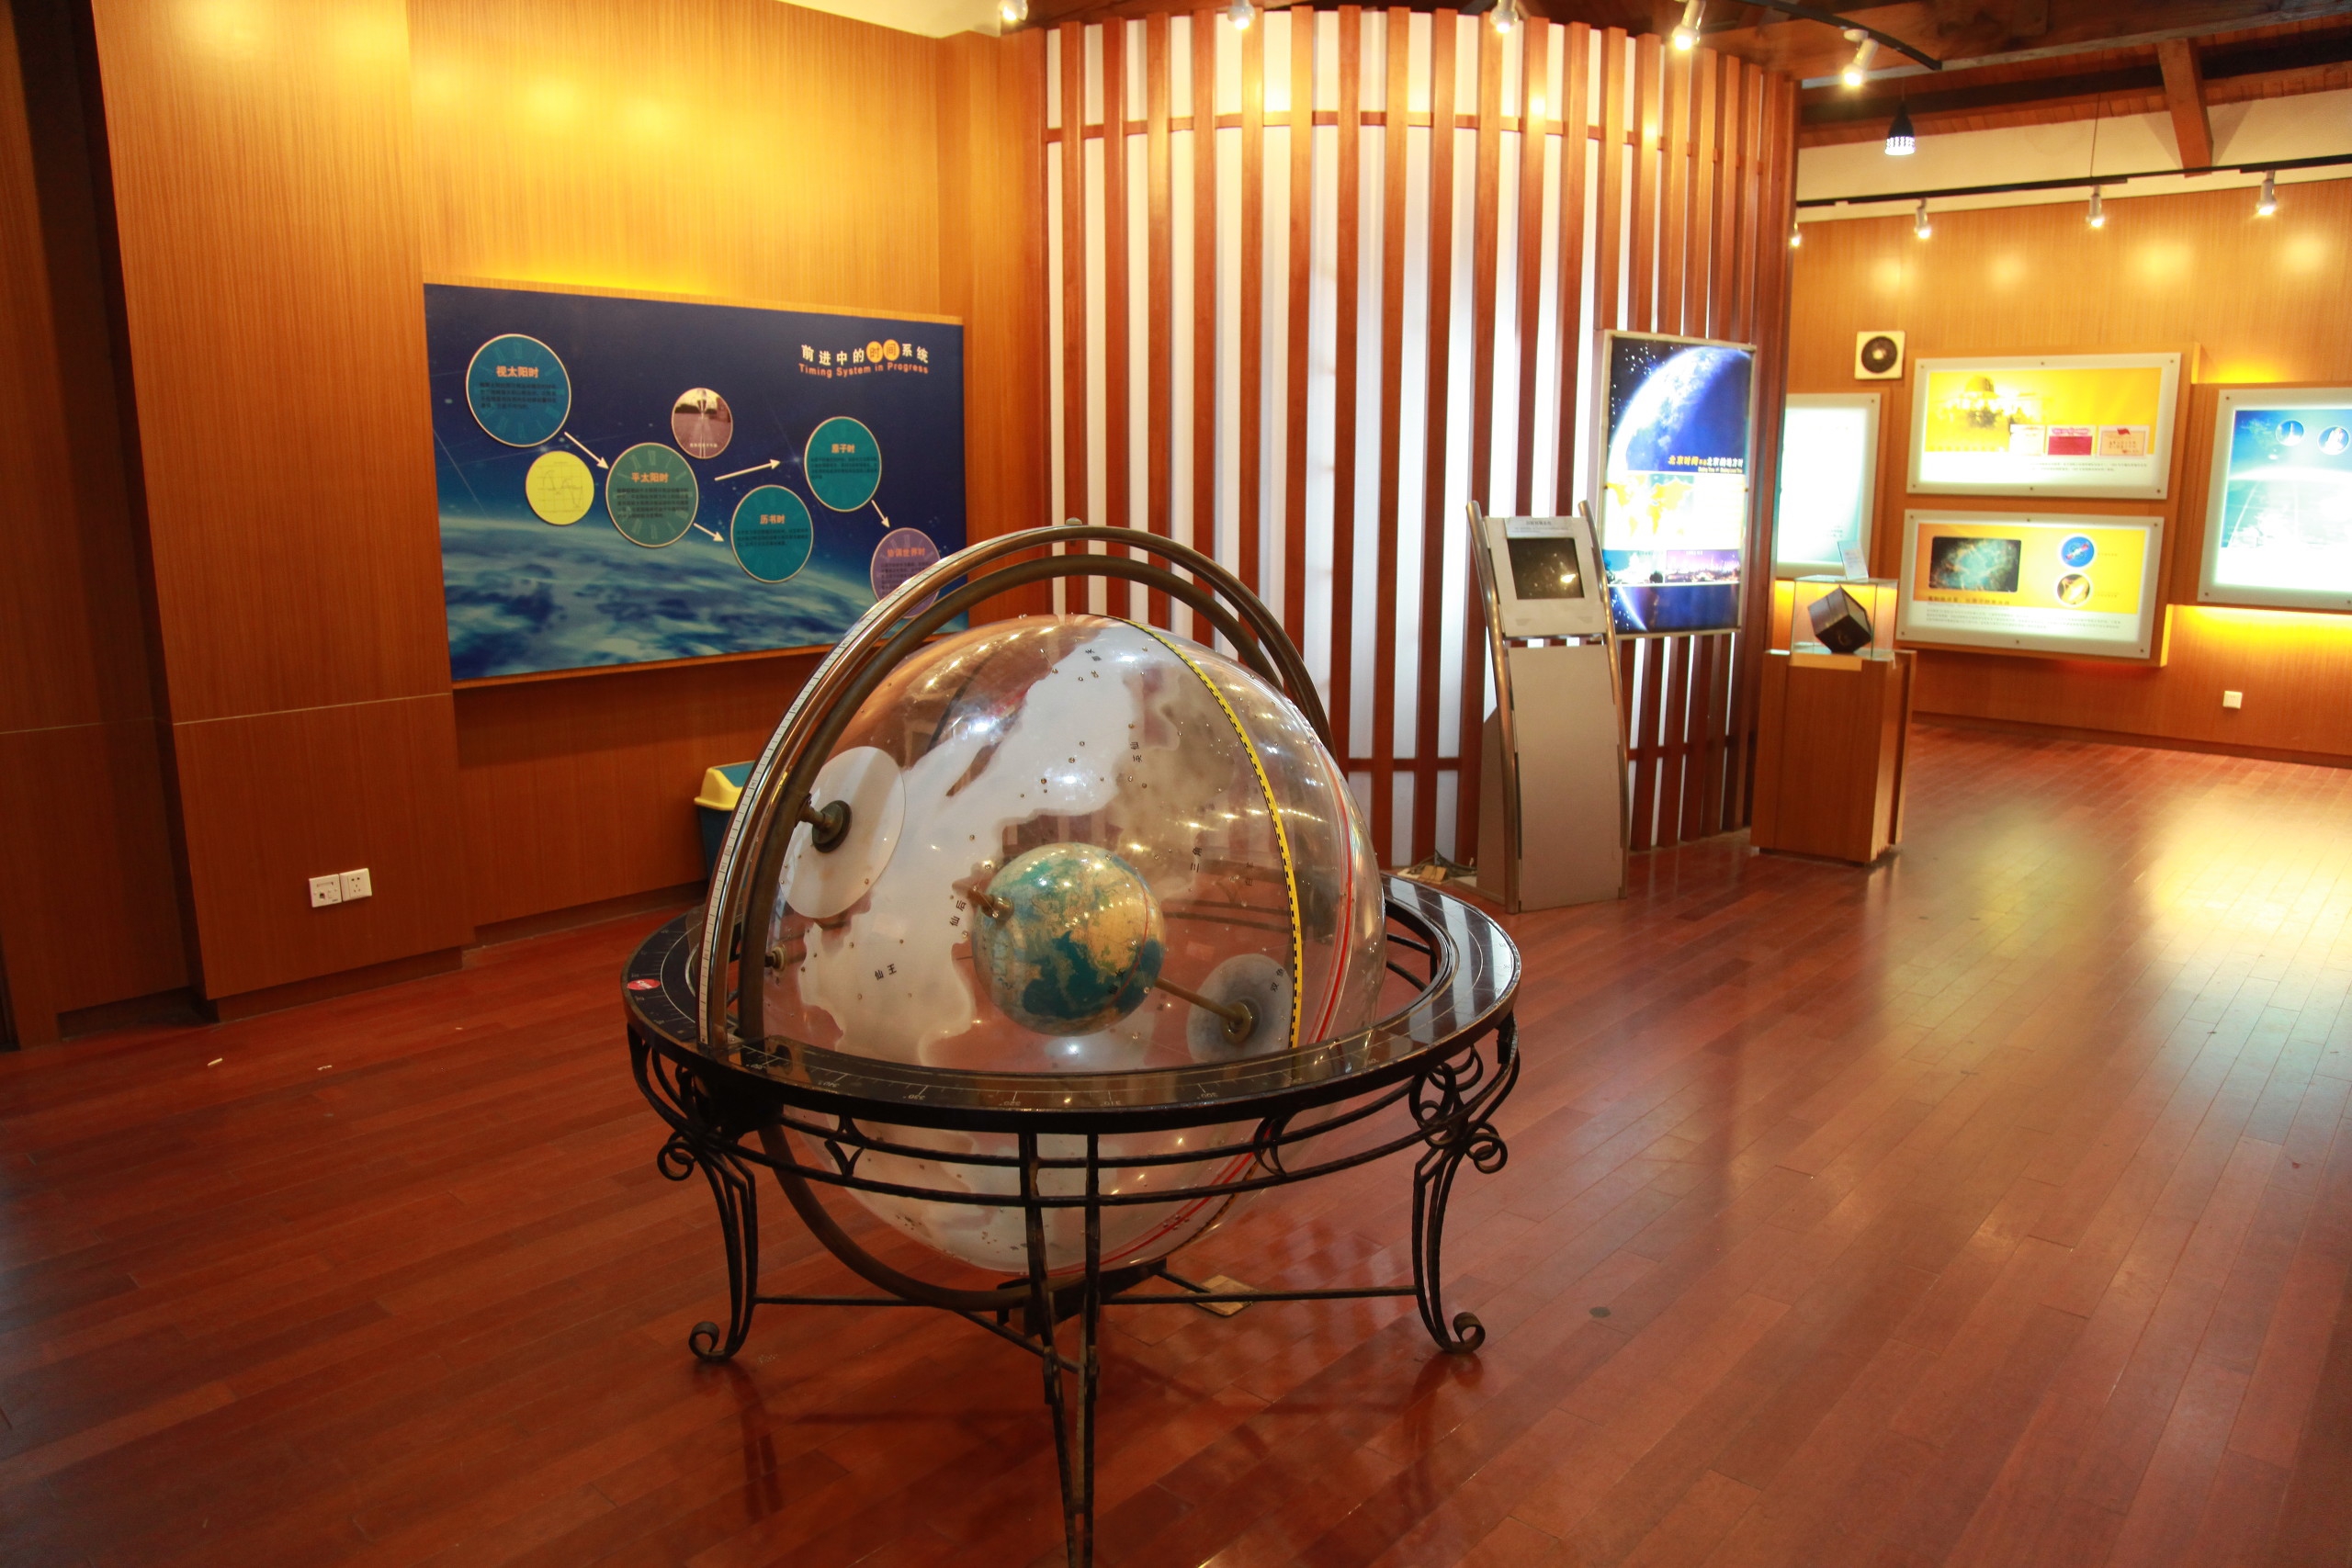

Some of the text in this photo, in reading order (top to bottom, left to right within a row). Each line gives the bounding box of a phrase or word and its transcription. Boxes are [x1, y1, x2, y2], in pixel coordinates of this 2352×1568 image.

[800, 343, 929, 366] 前进中的时间系统
[496, 366, 539, 378] 视太阳时
[798, 361, 929, 378] Timing System in Progress
[631, 472, 669, 483] 平太阳时
[1130, 741, 1142, 762] 英仙
[1190, 846, 1203, 874] 三角
[949, 899, 967, 927] 仙后
[875, 963, 898, 981] 仙王
